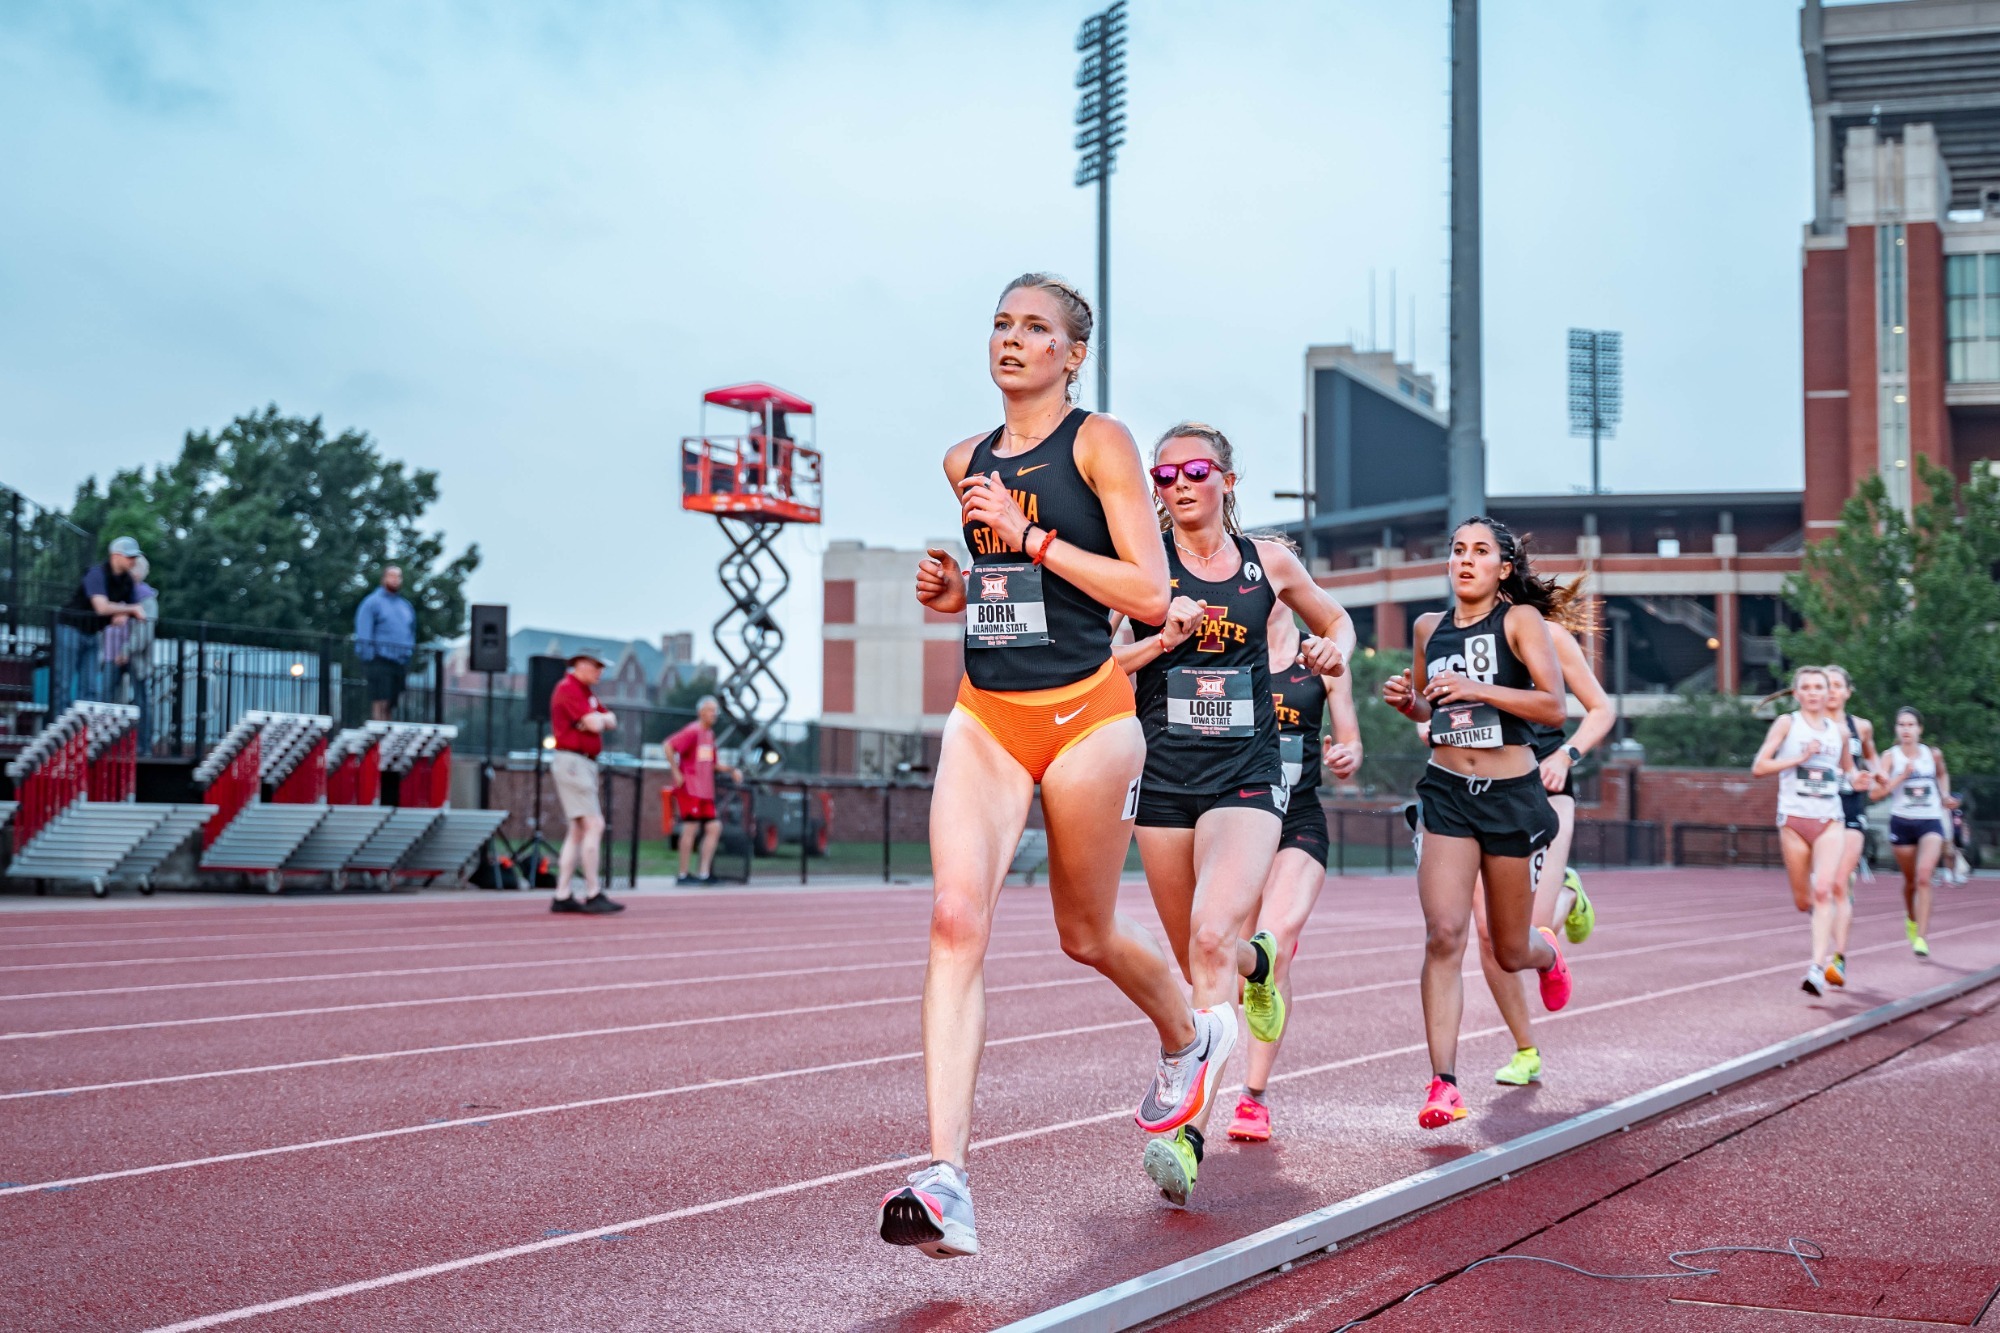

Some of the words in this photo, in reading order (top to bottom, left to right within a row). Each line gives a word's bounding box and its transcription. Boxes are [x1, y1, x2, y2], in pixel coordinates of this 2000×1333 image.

[973, 527, 1023, 554] STA
[978, 604, 1016, 623] BORN
[1005, 623, 1028, 633] STATE
[1195, 620, 1248, 644] TATE
[1471, 637, 1490, 673] 8
[1189, 701, 1232, 717] LOGUE
[1191, 716, 1210, 725] IOWA
[1210, 717, 1231, 725] STATE
[1439, 727, 1493, 746] MARTINEZ
